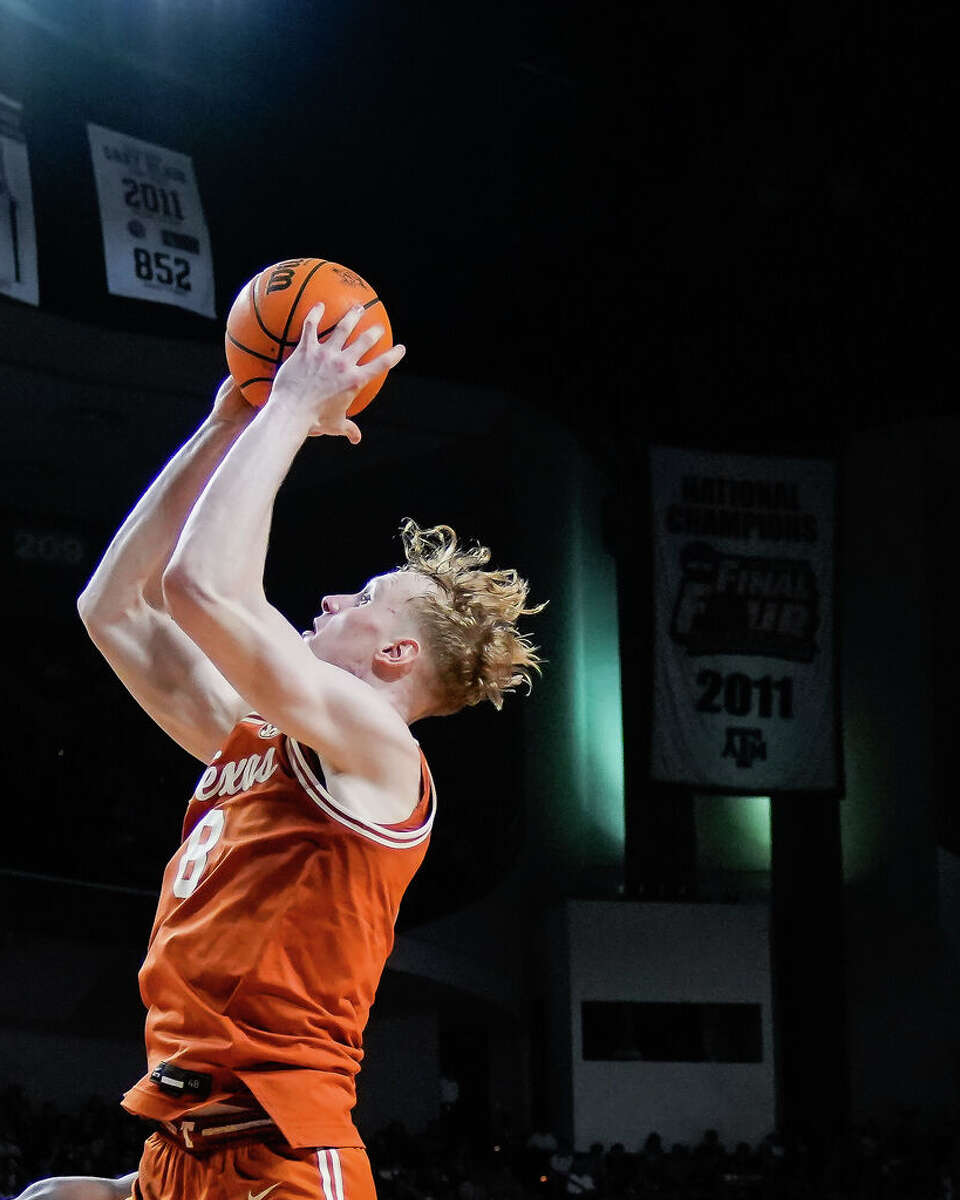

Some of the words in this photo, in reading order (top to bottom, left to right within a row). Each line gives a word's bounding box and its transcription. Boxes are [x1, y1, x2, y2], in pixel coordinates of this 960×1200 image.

[122, 177, 184, 221] 2011
[133, 247, 192, 292] 852
[696, 670, 793, 718] 2011
[195, 750, 278, 801] exas
[172, 809, 225, 898] 8
